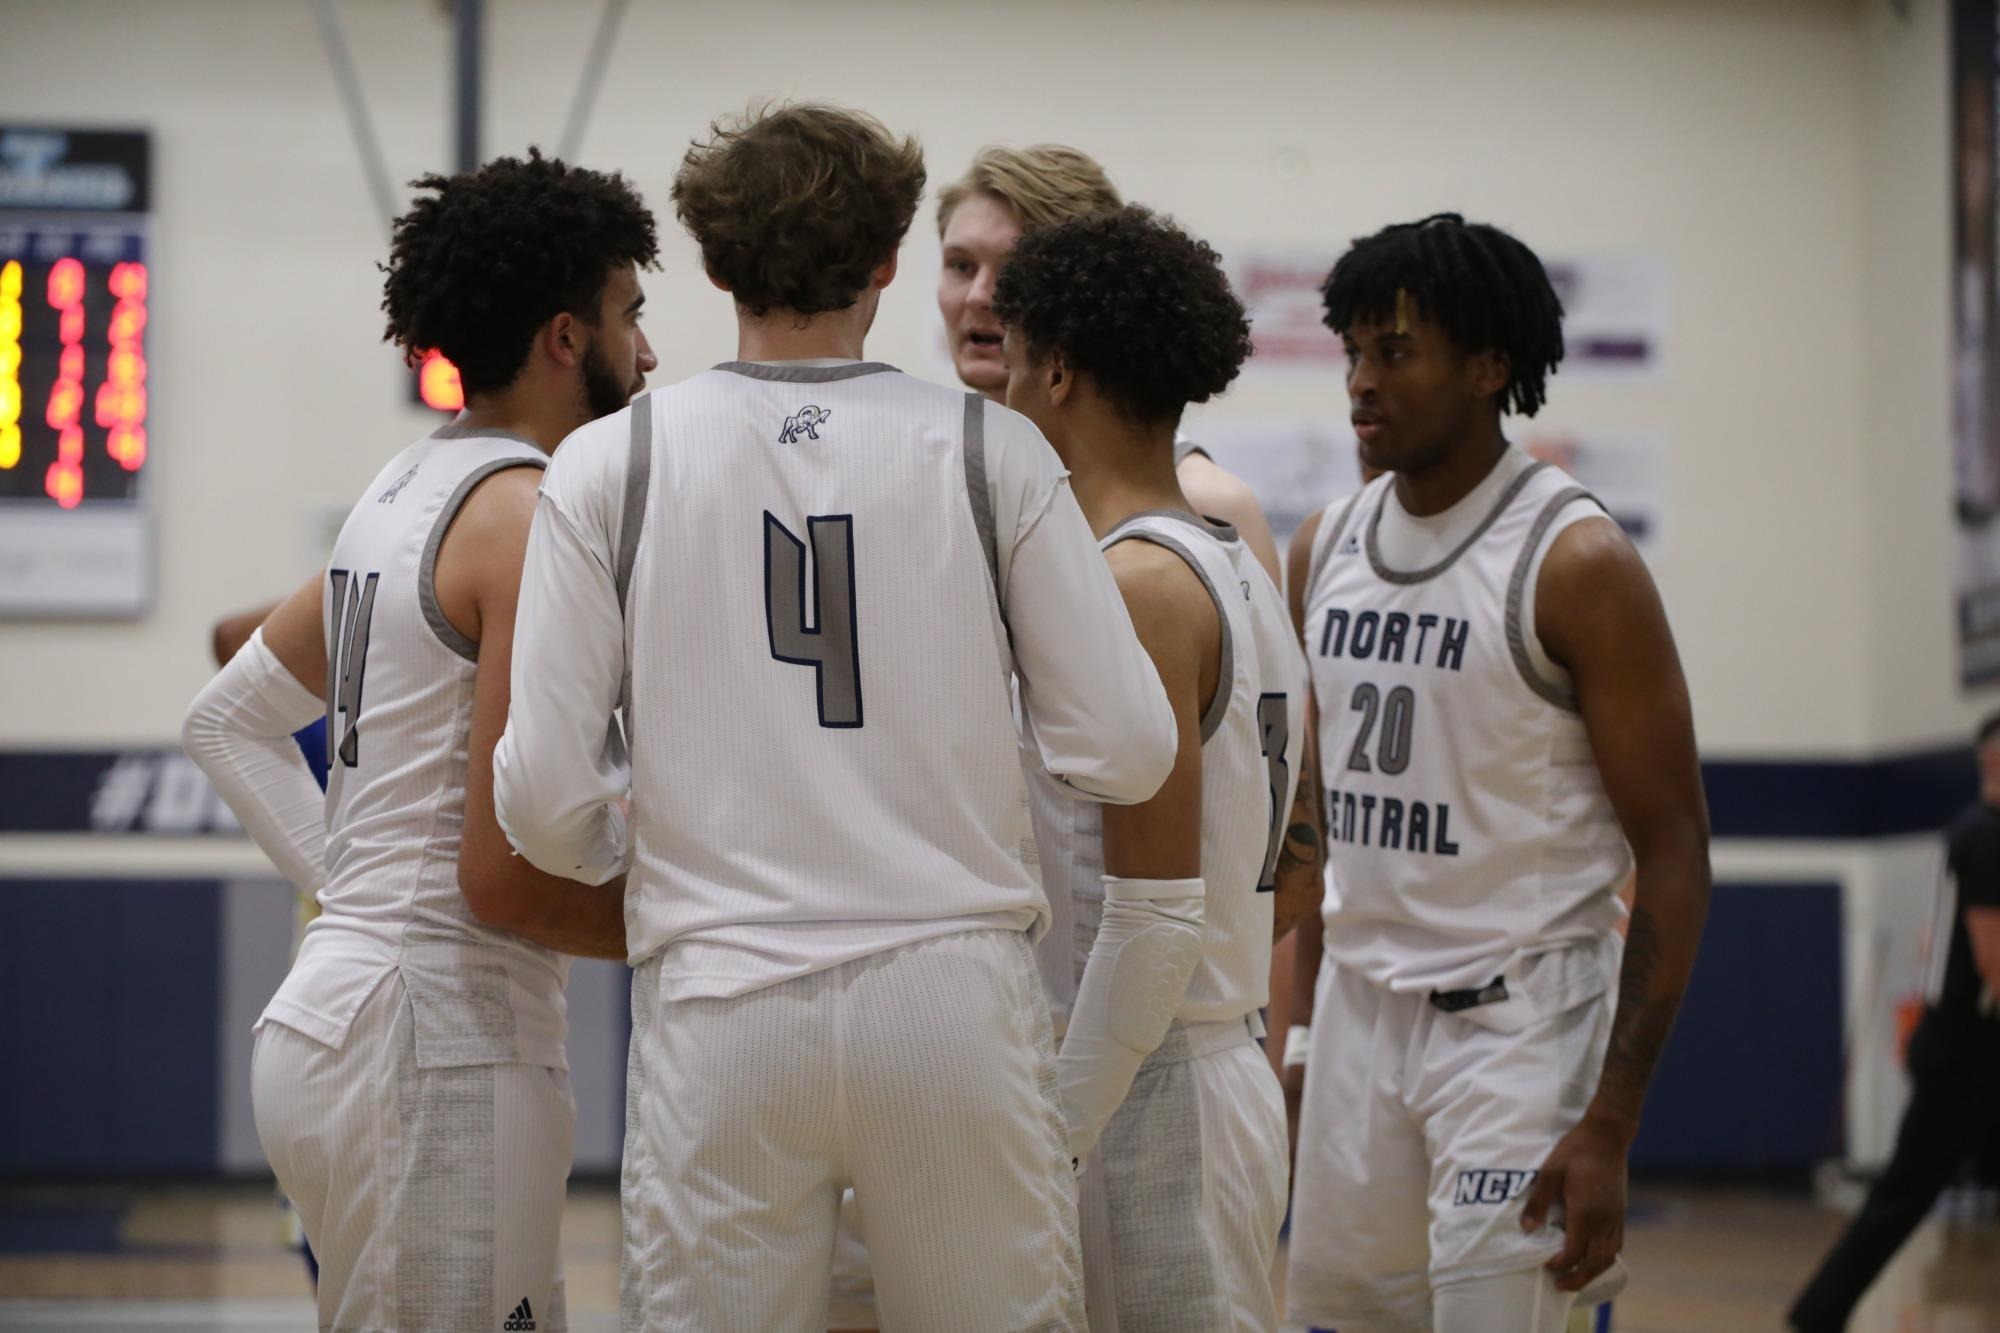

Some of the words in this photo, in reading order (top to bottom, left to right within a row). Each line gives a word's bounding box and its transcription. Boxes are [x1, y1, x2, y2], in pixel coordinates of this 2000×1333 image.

[763, 509, 864, 729] 4
[1319, 608, 1470, 671] NORTH
[1346, 682, 1416, 776] 20
[1324, 789, 1460, 856] ENTRAL
[503, 1320, 537, 1332] adidas
